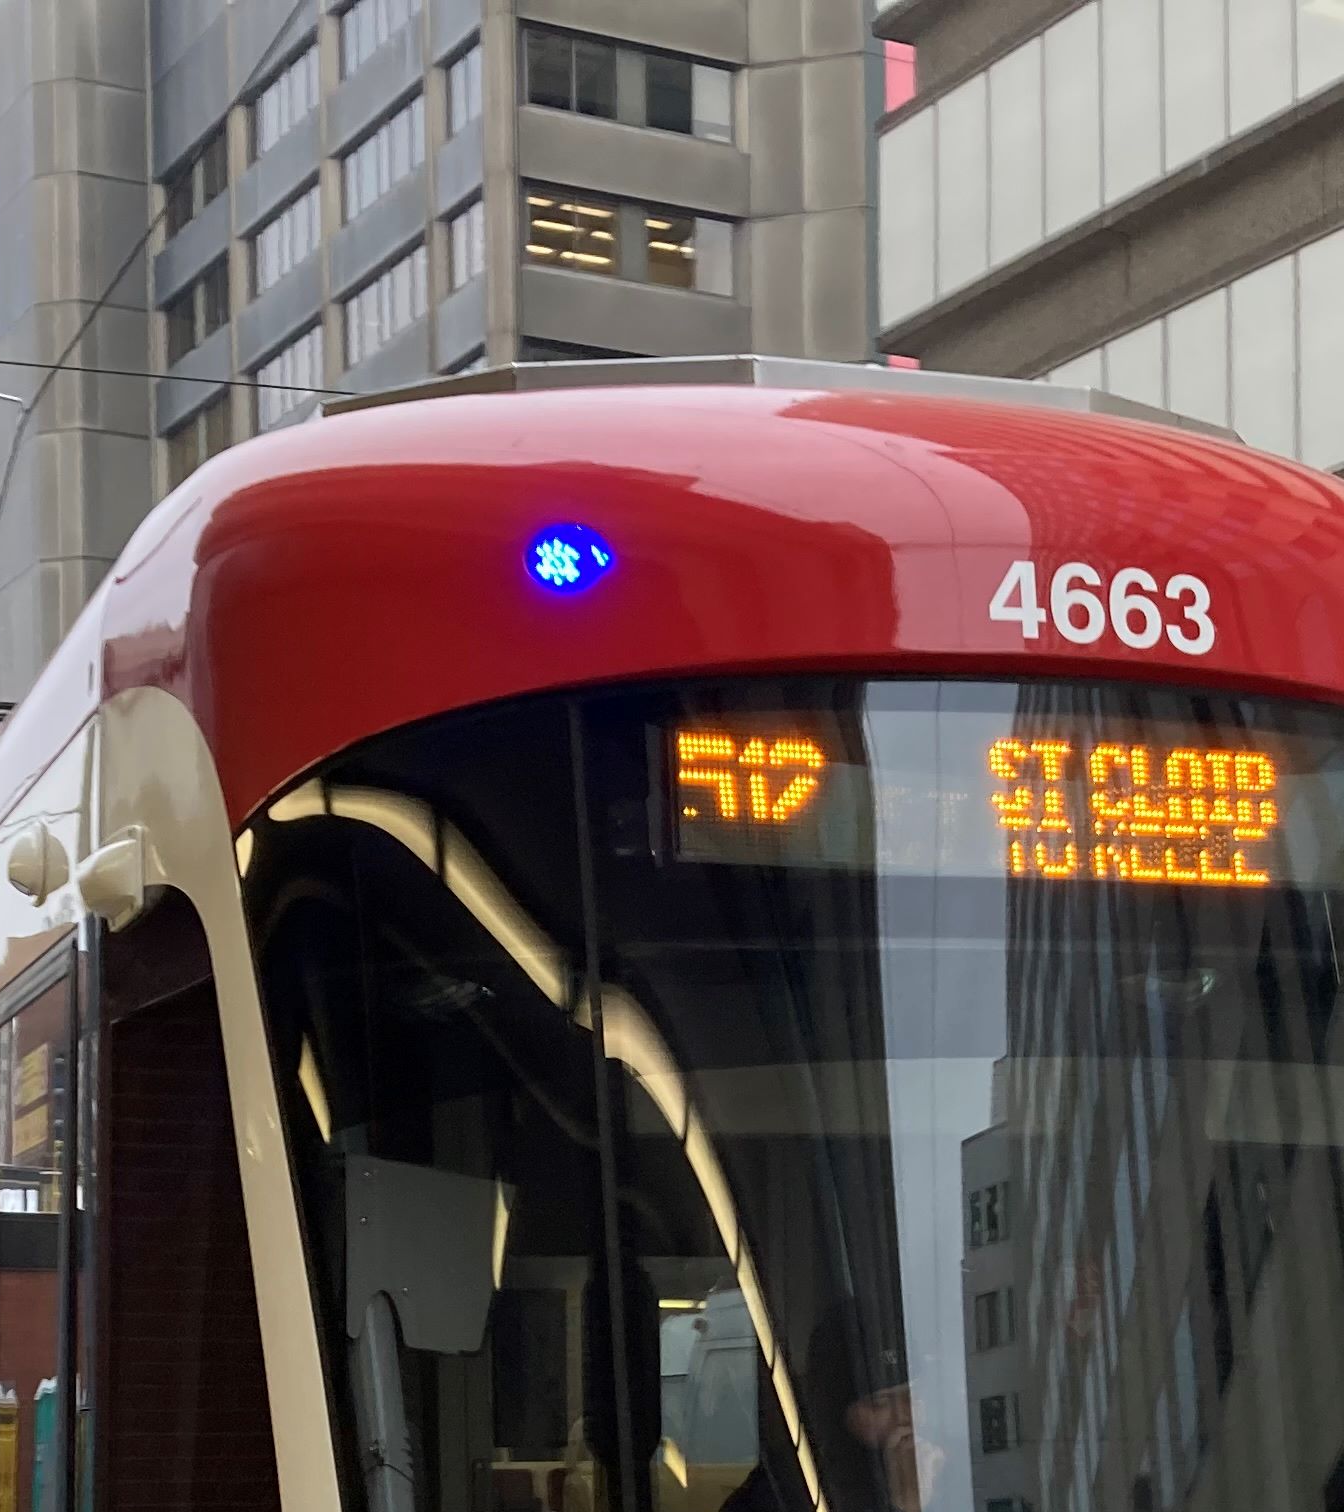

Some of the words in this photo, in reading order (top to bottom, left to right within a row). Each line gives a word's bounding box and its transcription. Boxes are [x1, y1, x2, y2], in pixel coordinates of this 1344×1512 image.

[989, 560, 1216, 655] 4663
[678, 733, 824, 820] 512
[988, 739, 1072, 813] ST
